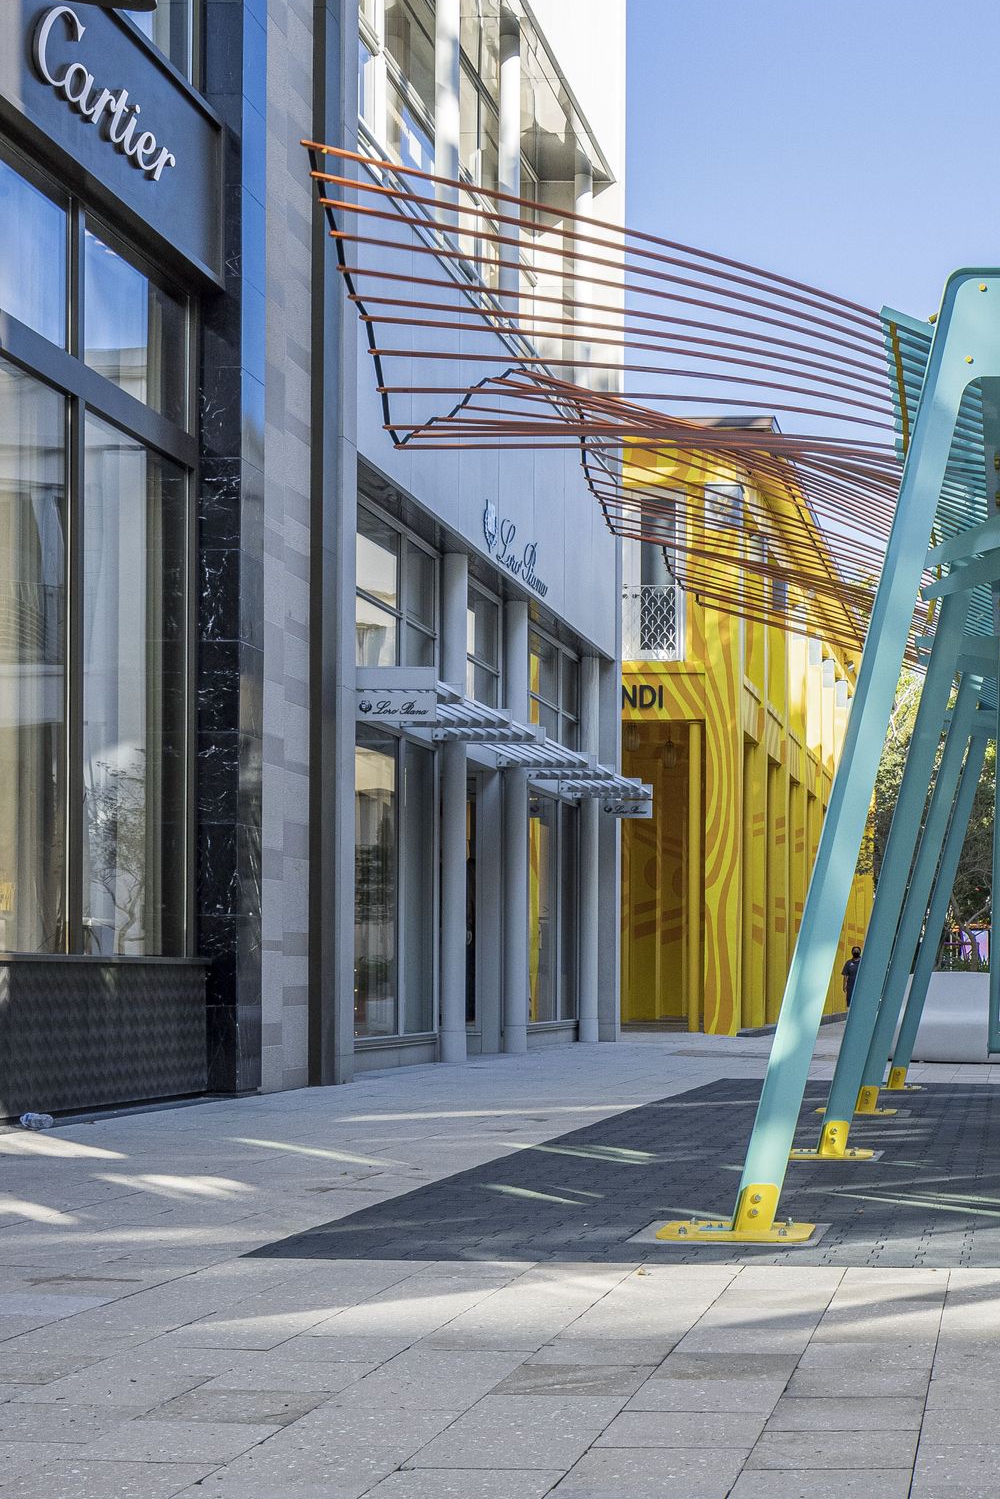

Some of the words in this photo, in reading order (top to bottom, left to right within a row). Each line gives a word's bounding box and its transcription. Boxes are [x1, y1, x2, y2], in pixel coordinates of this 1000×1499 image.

[36, 6, 177, 182] Cartier
[496, 518, 523, 575] Loro
[521, 542, 548, 597] Piana
[372, 700, 399, 715] Loro
[400, 700, 428, 715] Piana
[622, 684, 664, 709] NDI
